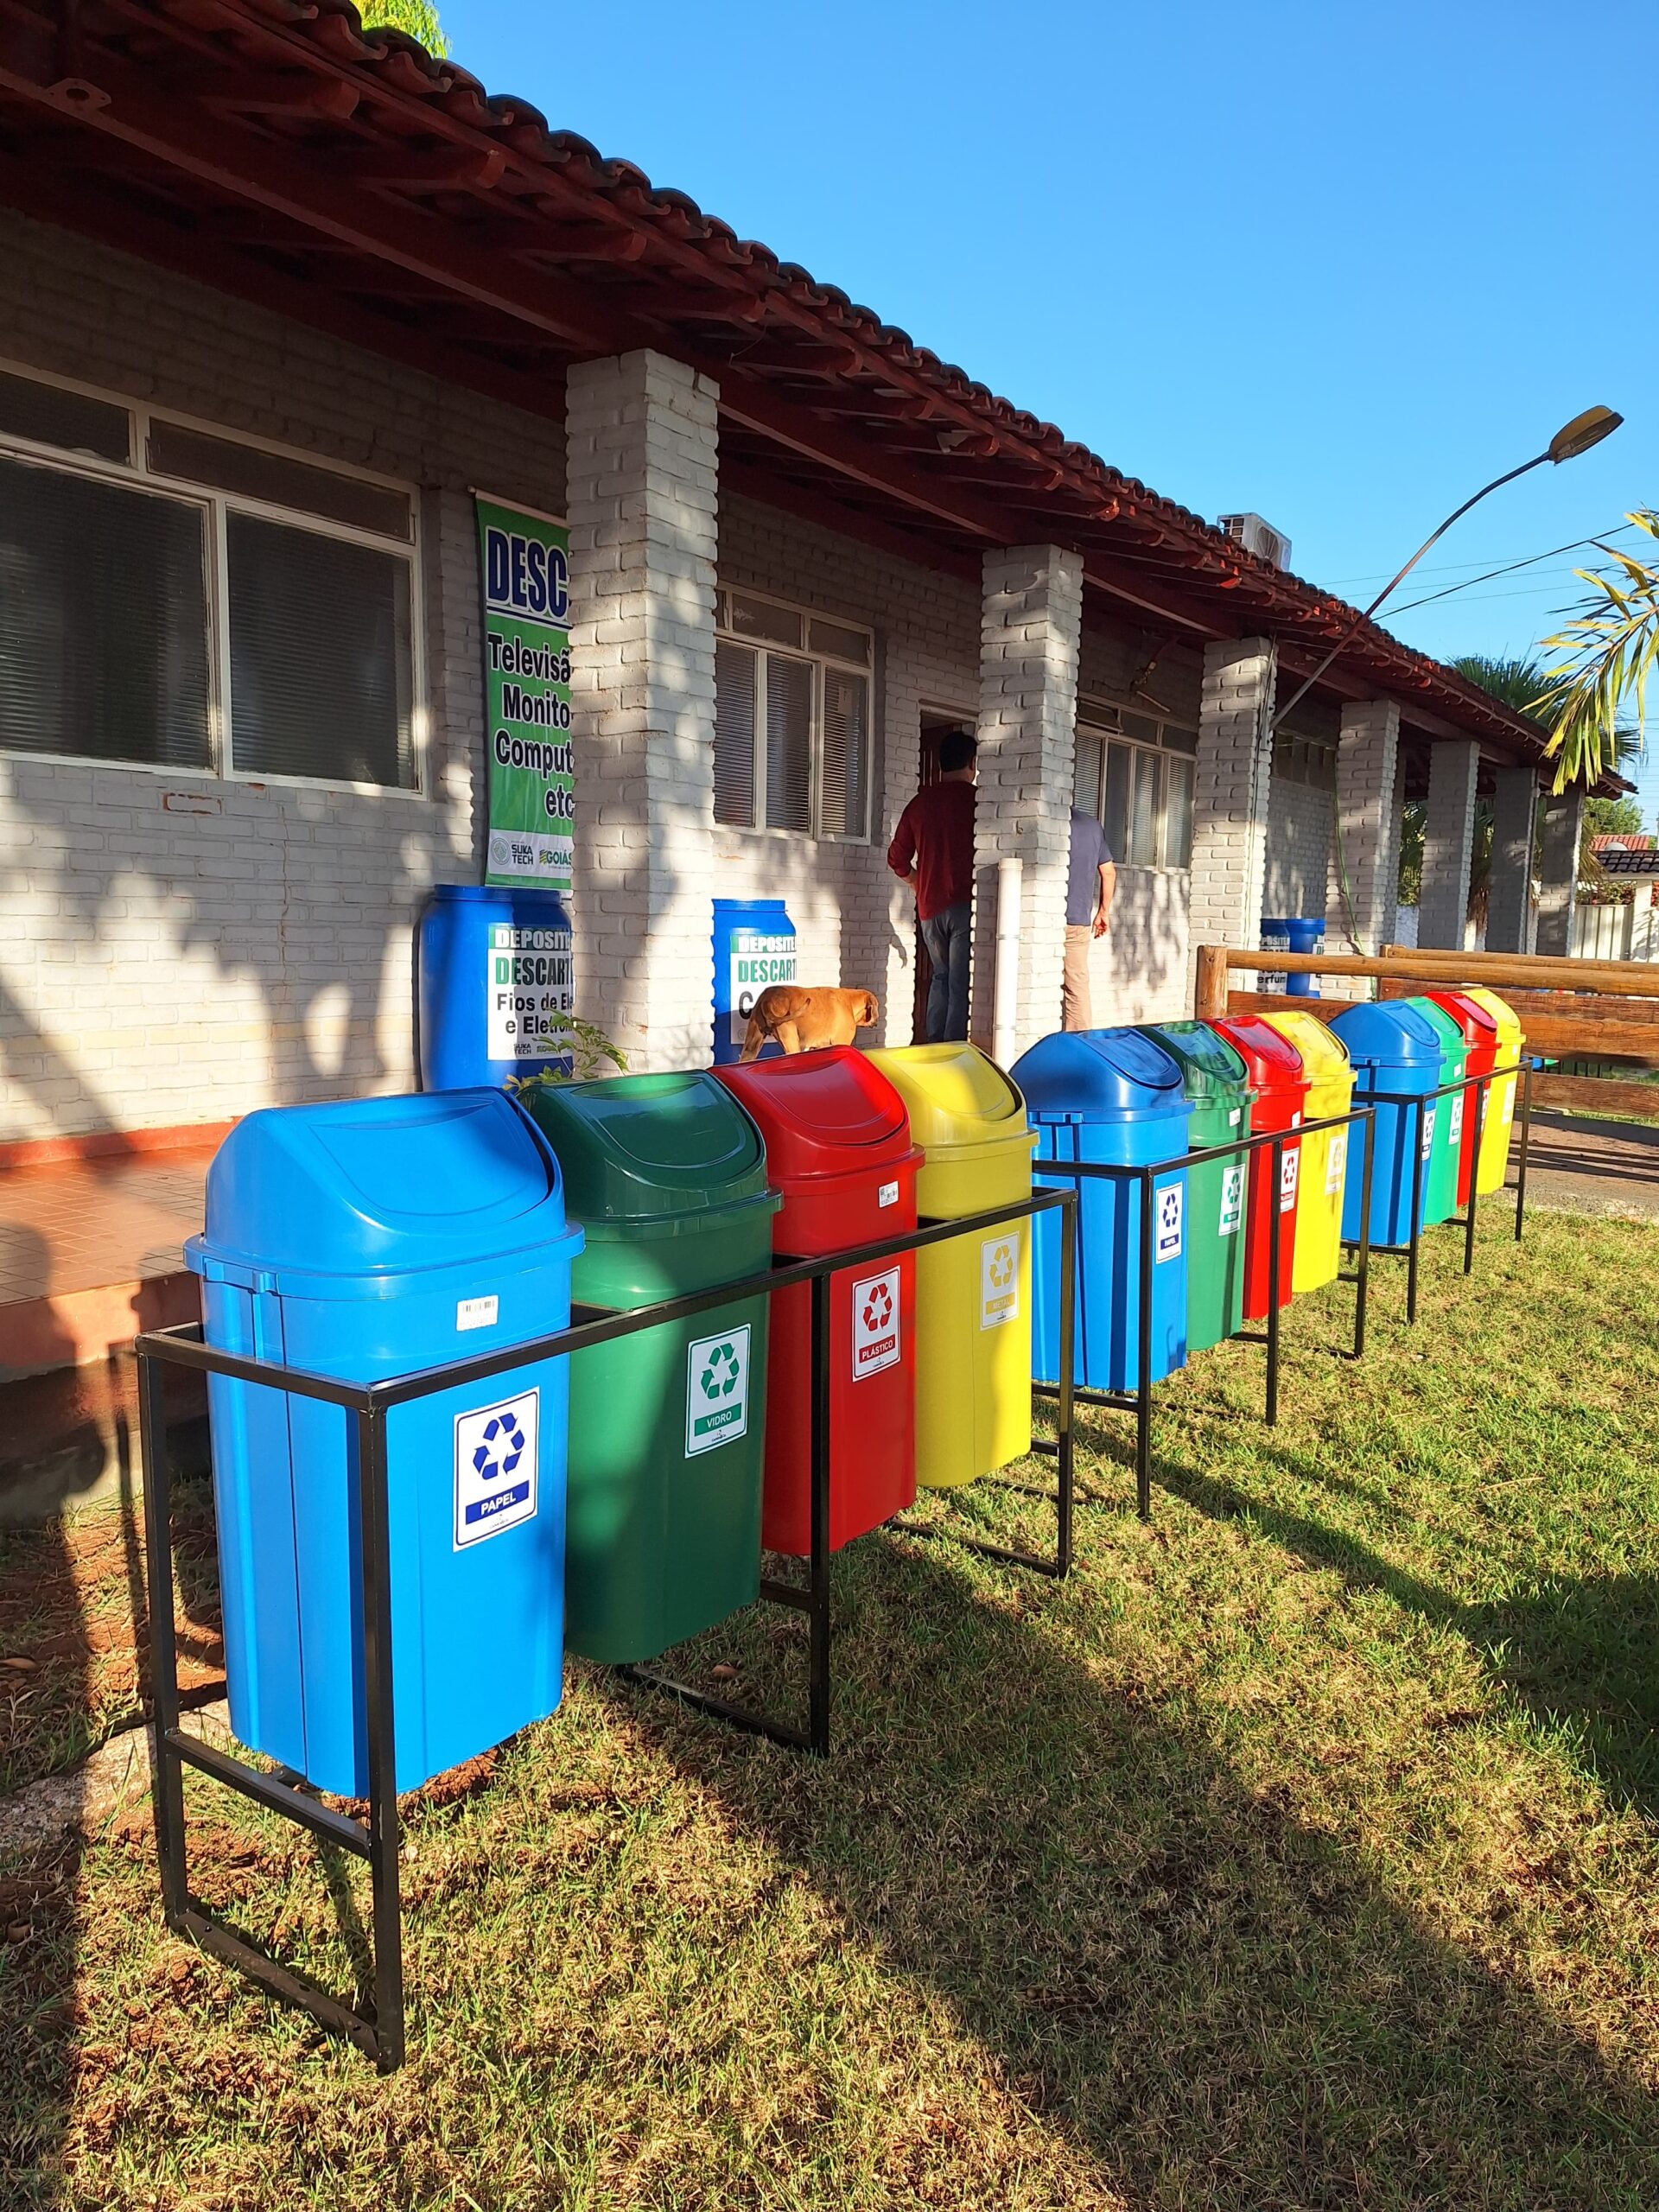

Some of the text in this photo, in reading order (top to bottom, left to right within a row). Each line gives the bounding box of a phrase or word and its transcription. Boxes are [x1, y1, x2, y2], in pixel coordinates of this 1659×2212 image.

[486, 526, 569, 620] DESC
[487, 633, 570, 684] Televisã
[503, 683, 570, 728] Monito
[495, 729, 572, 779] Comput
[512, 854, 534, 865] TECH
[496, 957, 572, 986] DESCART
[738, 958, 797, 982] DESCART
[497, 992, 535, 1011] Fios
[541, 992, 557, 1011] de
[505, 1020, 516, 1033] e
[861, 1339, 893, 1360] PLÁSTICO
[707, 1411, 732, 1428] VIDRO
[480, 1491, 517, 1516] PAPEL
